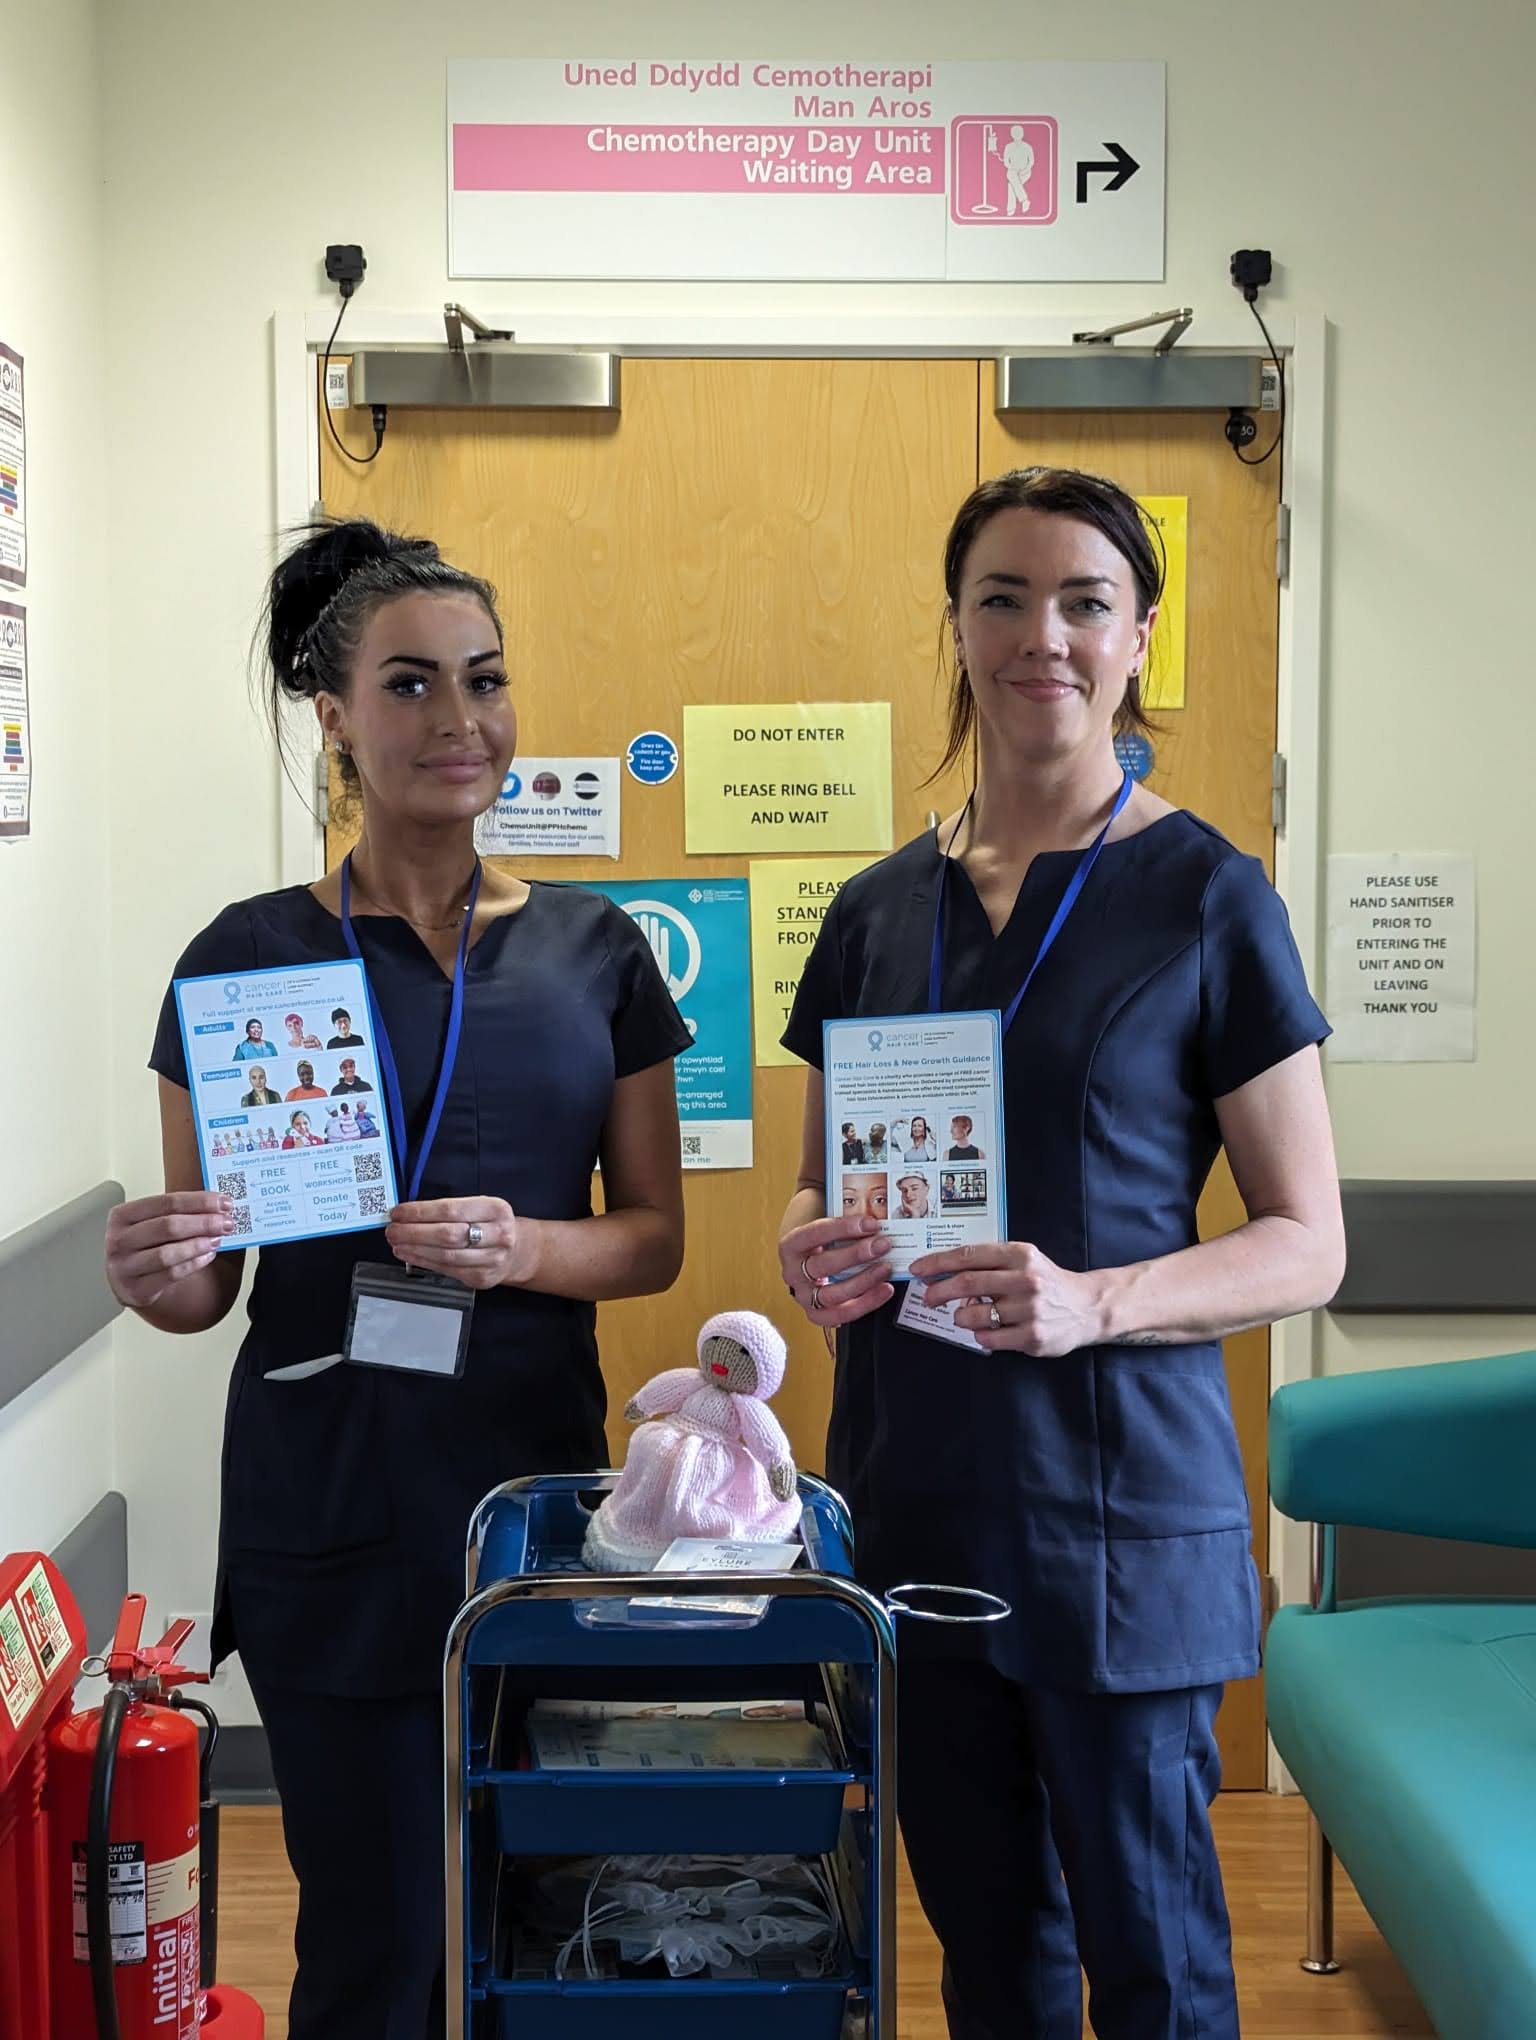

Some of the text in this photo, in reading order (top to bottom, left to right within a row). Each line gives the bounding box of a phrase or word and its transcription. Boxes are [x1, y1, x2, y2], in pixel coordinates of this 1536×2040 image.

[564, 62, 932, 94] Uned Ddydd Cemotherapi
[794, 96, 932, 118] Man Aros
[587, 127, 932, 159] Chemotherapy Day Unit
[743, 160, 932, 189] Waiting Area
[733, 728, 845, 741] DO NOT ENTER
[723, 783, 856, 797] PLEASE RING BELL
[531, 807, 544, 815] us
[546, 808, 560, 816] on
[564, 806, 602, 816] Twitter
[751, 811, 829, 824] AND WAIT
[799, 881, 844, 895] PLEA
[1366, 876, 1439, 888] PLEASE USE
[1350, 896, 1454, 909] HAND SANITISER
[777, 907, 829, 920] STAND
[1372, 918, 1432, 929] PRIOR TO
[1356, 938, 1447, 950] ENTERING THE
[1358, 959, 1444, 971] UNIT AND ON
[245, 981, 281, 993] cancer
[775, 981, 801, 994] RIN
[1374, 980, 1429, 991] LEAVING
[217, 1007, 247, 1018] support
[1364, 1002, 1438, 1014] THANK YOU
[203, 1023, 227, 1033] Adults
[886, 1032, 919, 1042] cancer
[833, 1061, 853, 1070] FREE
[855, 1061, 871, 1069] Hair
[873, 1060, 892, 1068] Loss
[902, 1058, 919, 1066] New
[921, 1055, 950, 1065] Growth
[952, 1055, 991, 1063] Guidance
[203, 1070, 241, 1081] Teenagers
[691, 1101, 706, 1109] this
[212, 1117, 245, 1127] Children
[260, 1159, 339, 1179] FREE FREE
[260, 1176, 354, 1197] BOOK WORKSHOPS
[313, 1193, 349, 1206] Donate
[318, 1211, 348, 1223] Today
[119, 1852, 134, 1861] LTD
[152, 1928, 177, 2024] Initial
